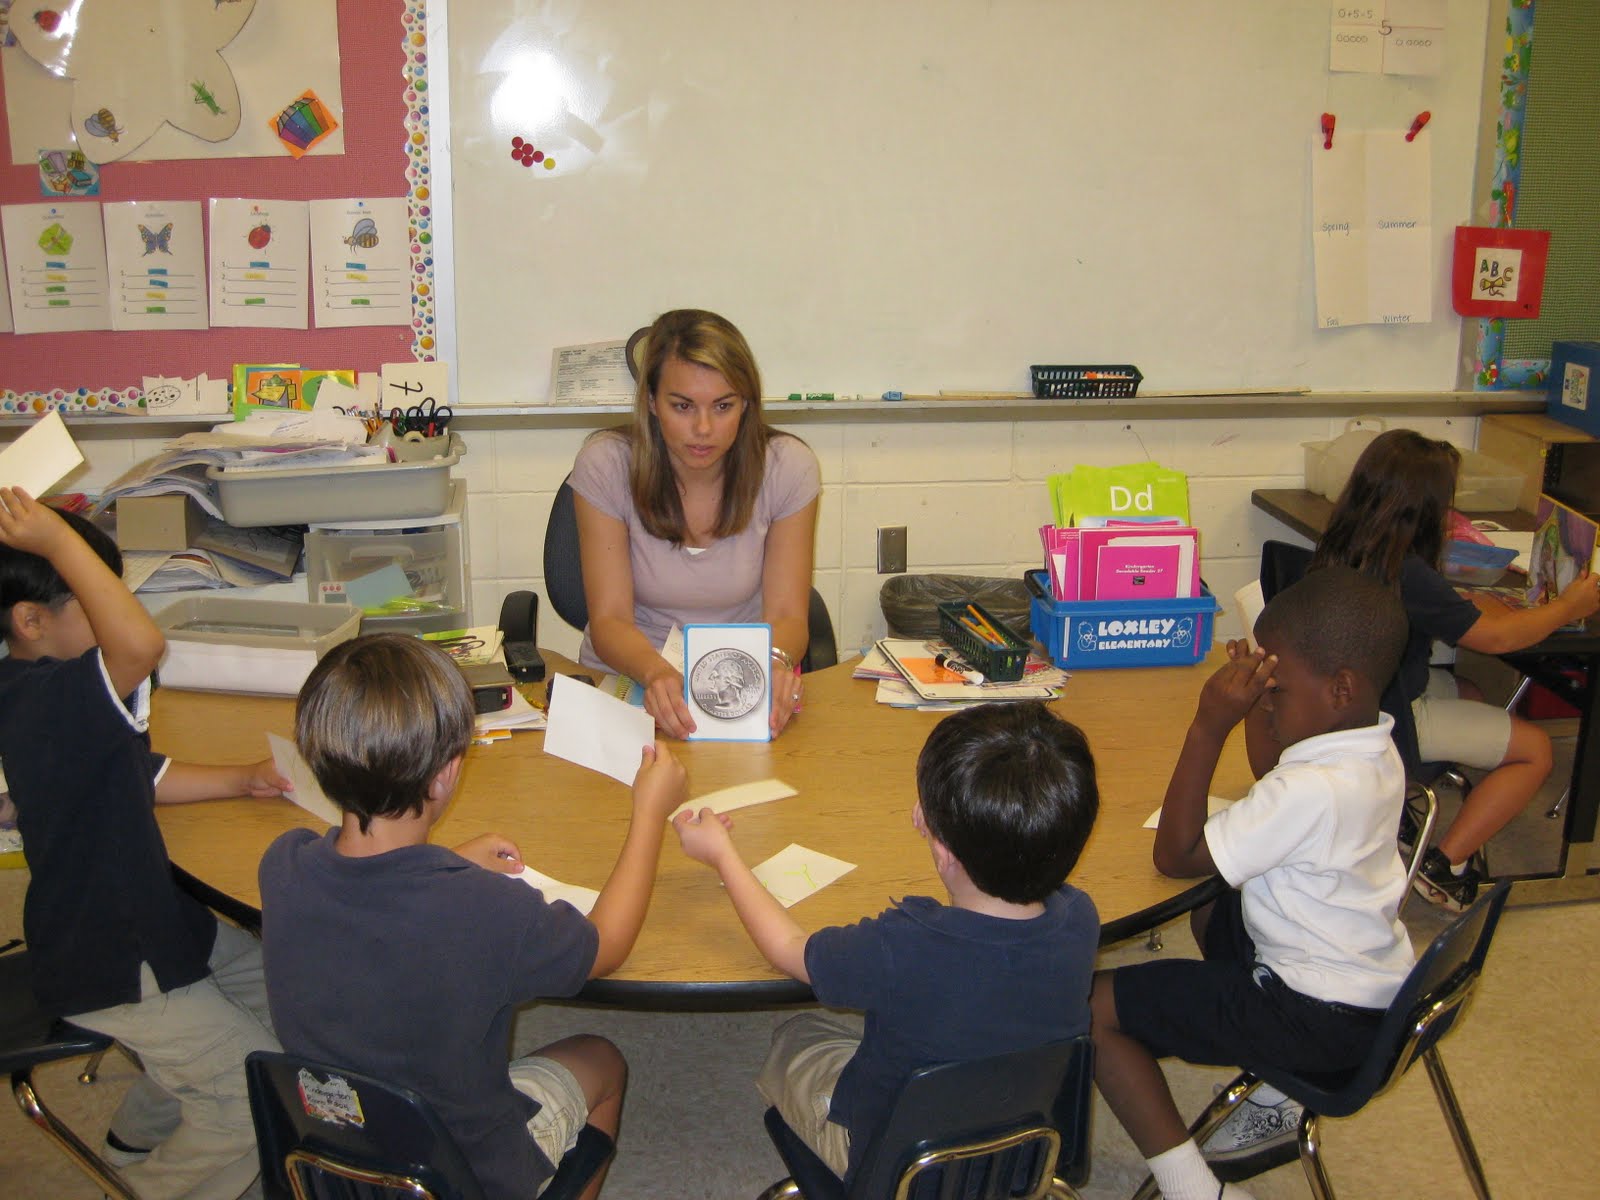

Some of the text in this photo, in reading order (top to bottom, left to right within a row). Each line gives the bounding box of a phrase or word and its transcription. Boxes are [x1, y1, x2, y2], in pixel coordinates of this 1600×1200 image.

[1378, 20, 1393, 36] 5
[1378, 219, 1417, 230] Summer
[1383, 314, 1411, 323] Winter
[1109, 483, 1154, 512] Dd
[1098, 618, 1176, 637] LOXLEY
[1098, 638, 1171, 651] ELEMENTARY
